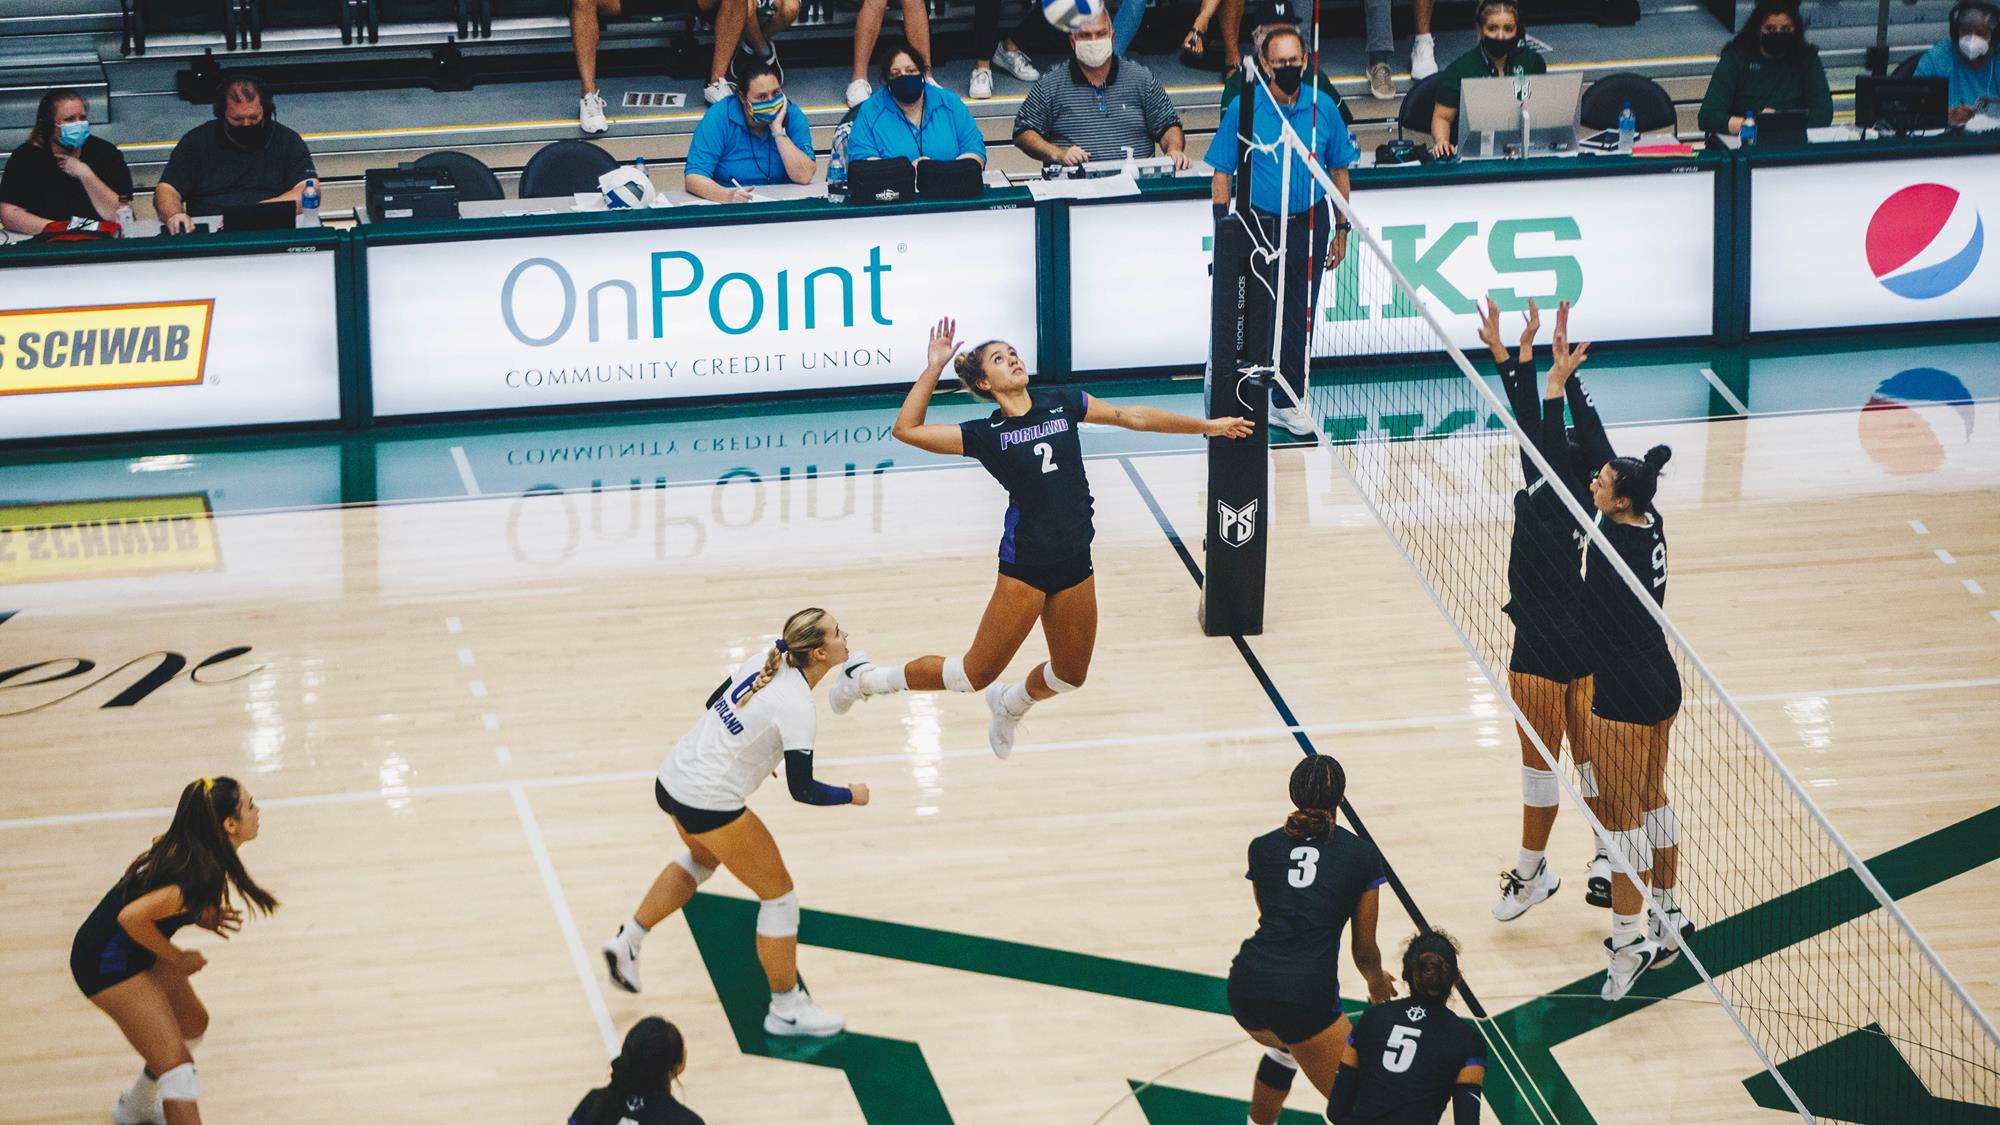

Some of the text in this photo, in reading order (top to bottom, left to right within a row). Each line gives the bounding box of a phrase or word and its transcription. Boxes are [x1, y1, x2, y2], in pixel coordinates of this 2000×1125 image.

[1203, 216, 1584, 322] IKS
[501, 245, 893, 347] OnPoint
[16, 324, 191, 370] SCHWAB
[505, 347, 892, 389] COMMUNITY CREDIT UNION
[1000, 418, 1069, 450] PORTLAND
[1033, 442, 1059, 474] 2
[1652, 542, 1668, 588] 9
[1287, 846, 1320, 888] 3
[1382, 1024, 1422, 1073] 5
